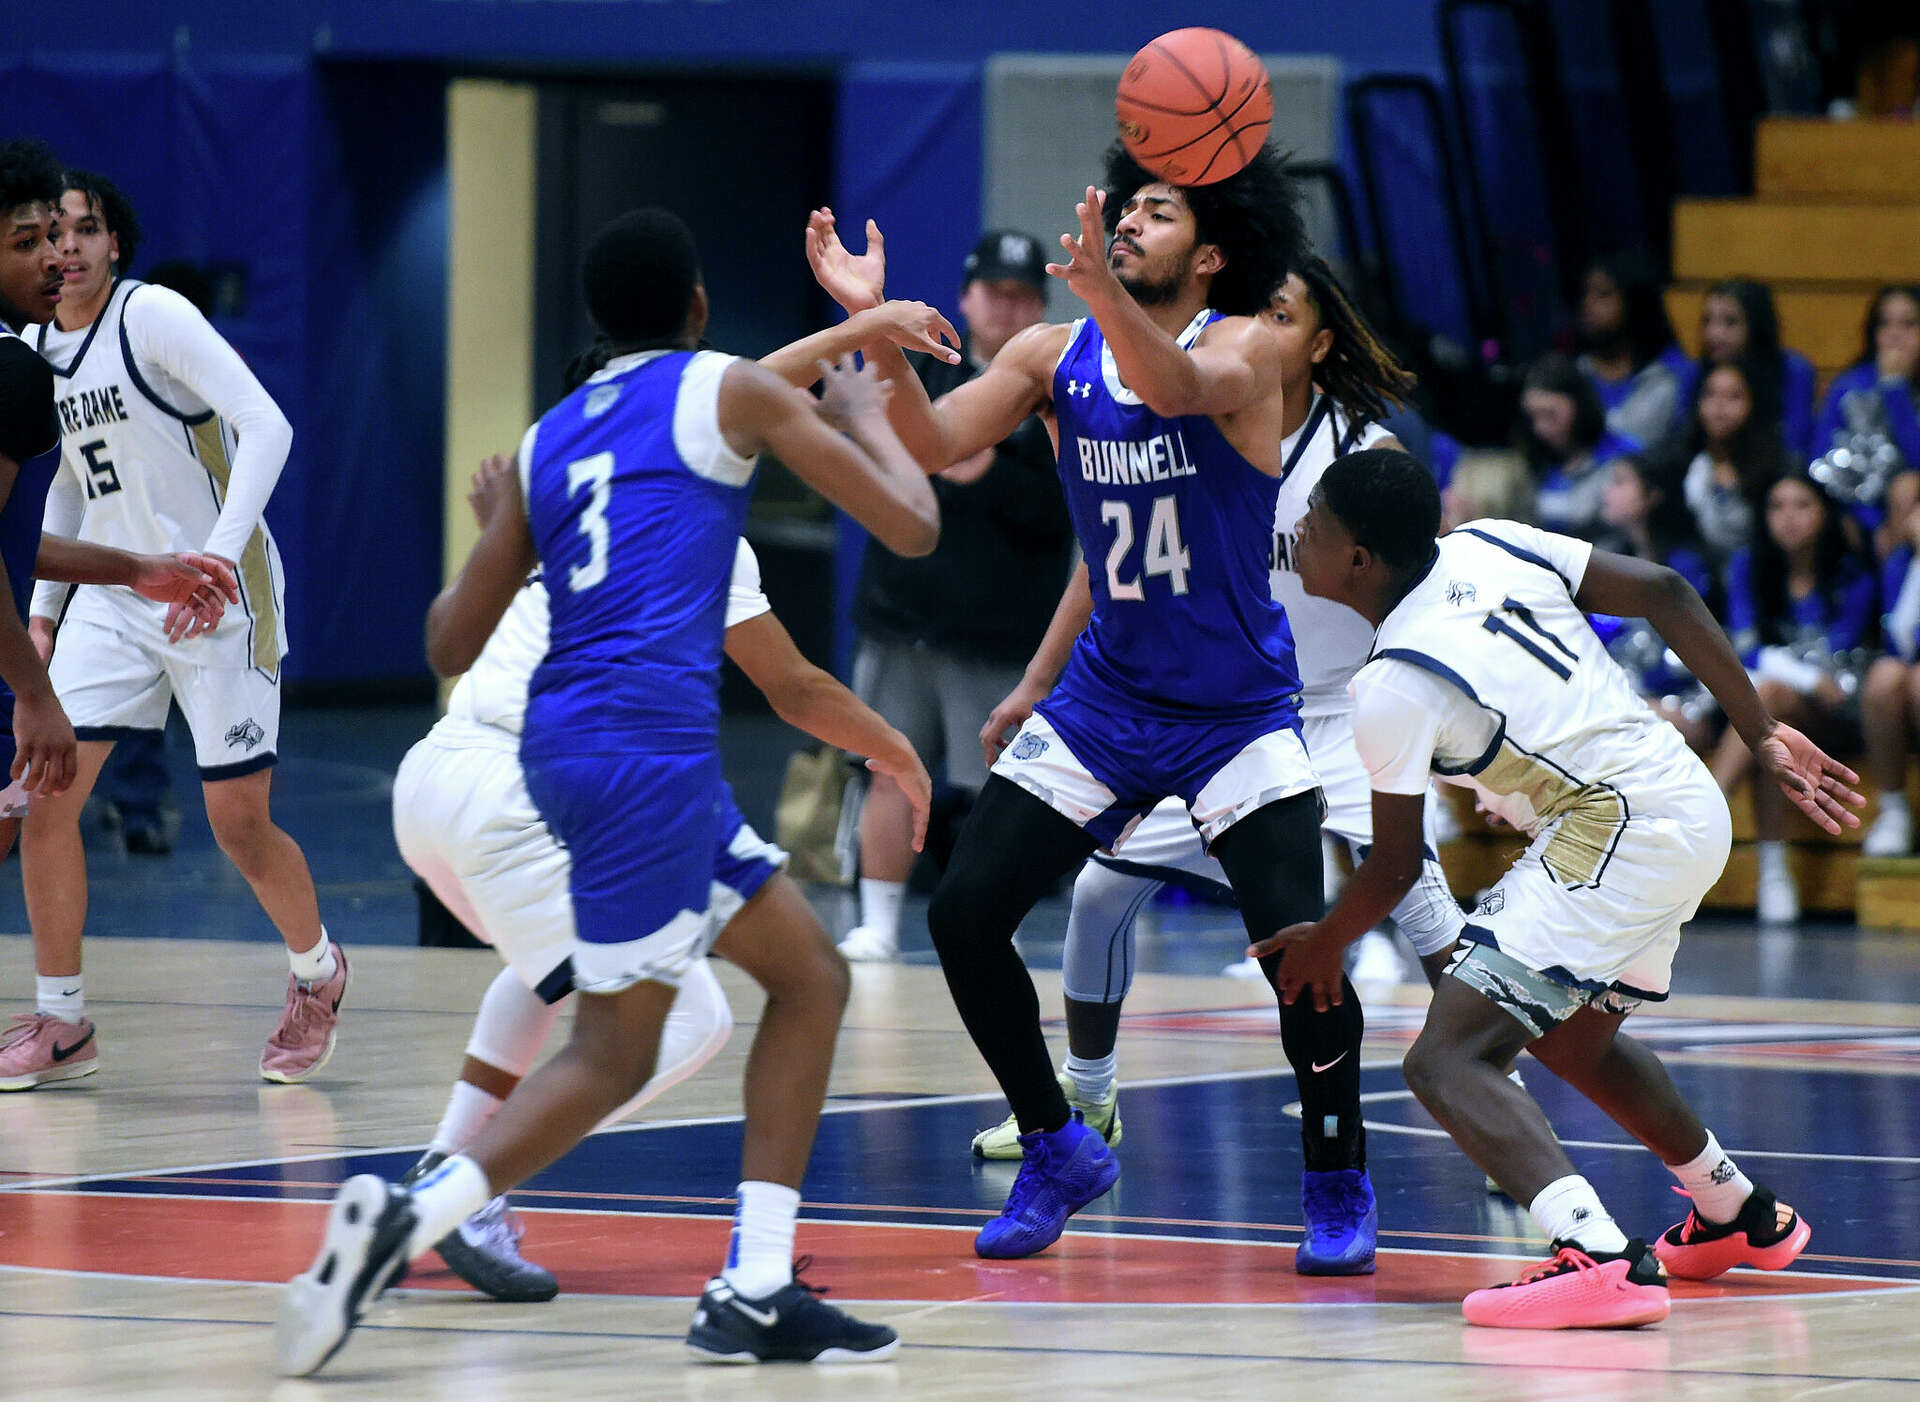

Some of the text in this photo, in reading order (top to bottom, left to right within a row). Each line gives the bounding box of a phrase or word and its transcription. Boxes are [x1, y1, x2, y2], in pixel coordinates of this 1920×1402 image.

[80, 385, 128, 427] DAME
[80, 438, 122, 499] 15
[1077, 431, 1197, 485] BUNNELL
[567, 451, 615, 592] 3
[1101, 494, 1191, 601] 24
[1482, 595, 1579, 682] 11
